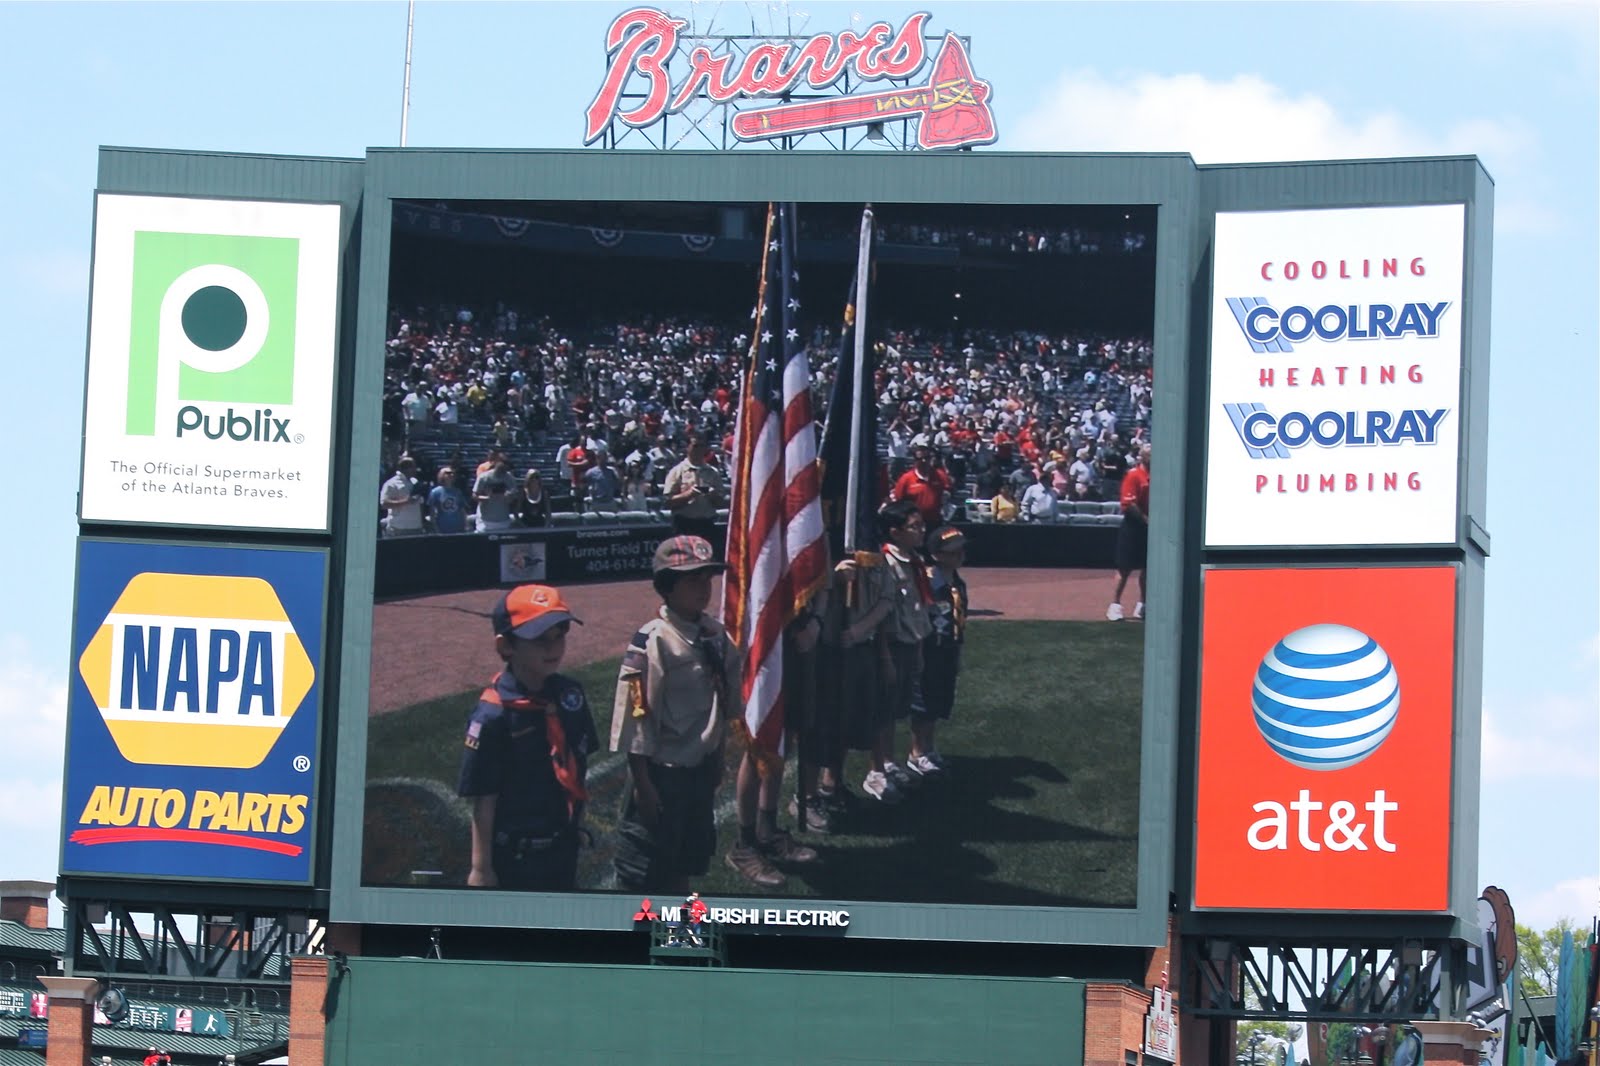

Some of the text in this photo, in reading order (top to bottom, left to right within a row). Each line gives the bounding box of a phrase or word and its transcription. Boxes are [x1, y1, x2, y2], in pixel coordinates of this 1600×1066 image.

[584, 6, 933, 146] Braves
[1261, 257, 1425, 281] COOLING
[1246, 301, 1450, 341] COOLRAY
[1259, 364, 1423, 387] HEATING
[176, 405, 291, 443] Publix
[1243, 408, 1448, 446] COOLRAY
[110, 460, 301, 481] The Official Supermarket
[1256, 471, 1421, 493] PLUMBING
[121, 479, 288, 499] of the Atlanta Braves.
[576, 530, 630, 538] braves.com
[567, 545, 608, 558] Turner
[610, 542, 640, 555] Field
[120, 624, 275, 717] NAPA
[79, 785, 309, 835] AUTO PARTS
[1247, 789, 1398, 852] at&t
[661, 906, 849, 927] MIUBISHI ELECTRIC
